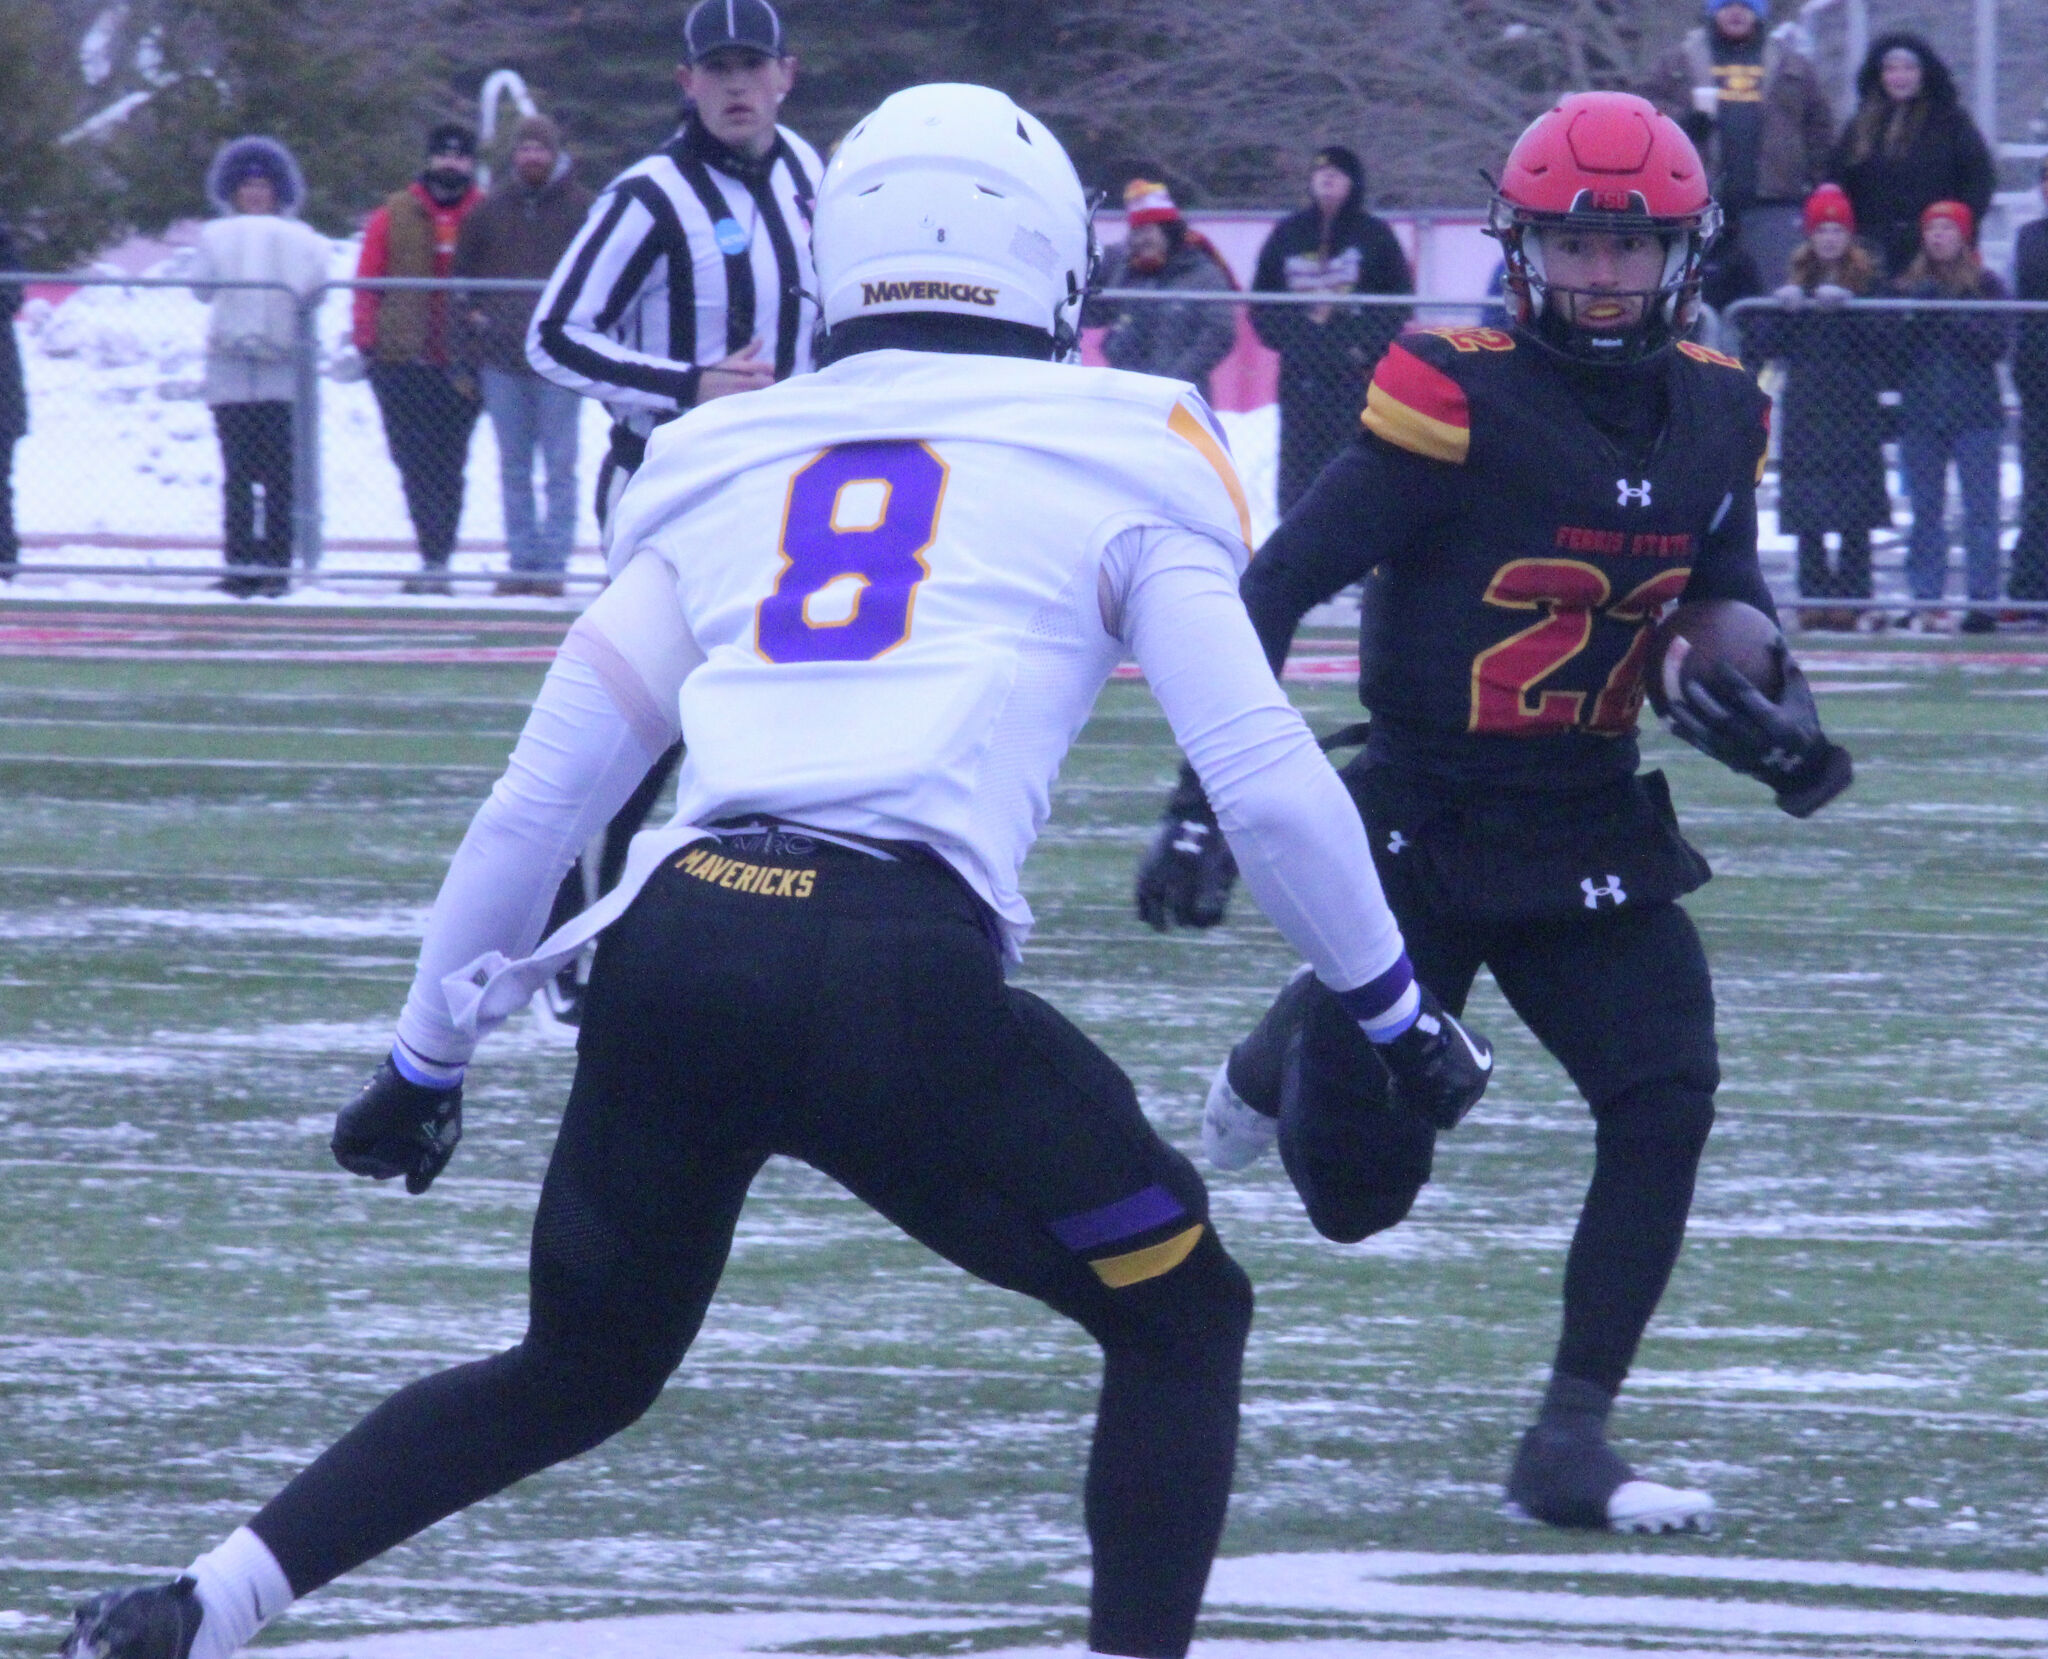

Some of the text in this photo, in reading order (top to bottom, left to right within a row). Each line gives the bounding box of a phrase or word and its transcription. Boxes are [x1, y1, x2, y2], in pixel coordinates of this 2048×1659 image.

[1592, 191, 1630, 209] FSU
[937, 228, 945, 243] 8
[861, 281, 999, 306] MAVERICKS
[754, 438, 950, 664] 8
[675, 849, 817, 898] MAVERICKS
